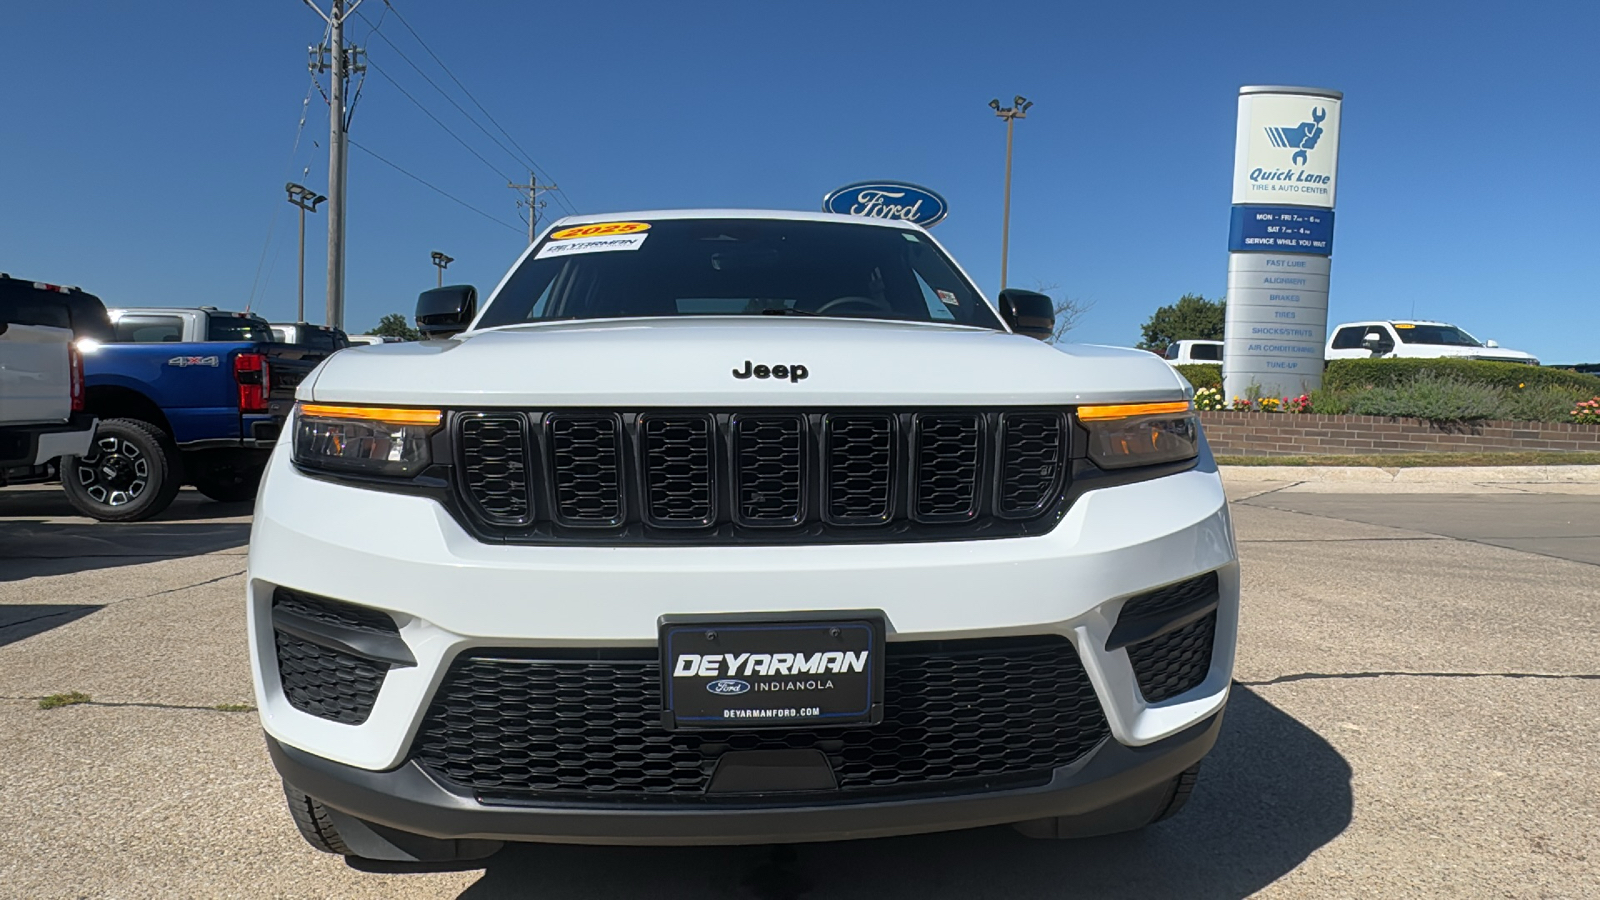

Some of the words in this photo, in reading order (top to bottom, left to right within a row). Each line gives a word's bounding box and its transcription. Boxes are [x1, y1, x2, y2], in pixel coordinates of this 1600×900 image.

[1250, 168, 1295, 182] Quick
[1296, 170, 1331, 184] Lane
[1301, 186, 1328, 194] CENTER
[850, 190, 923, 220] Ford
[561, 224, 640, 238] 2025
[1276, 238, 1297, 246] WHILE
[1266, 259, 1286, 267] FAST
[1263, 277, 1306, 286] ALIGNMENT
[1269, 294, 1300, 302] BRAKES
[1274, 311, 1296, 319] TIRES
[1252, 327, 1313, 337] SHOCKS/STRUTS
[1263, 345, 1315, 354] CONDITIONING
[1266, 361, 1298, 369] TUNE-UP
[732, 360, 809, 383] Jeep
[673, 651, 868, 677] DEYARMAN
[714, 679, 742, 693] Ford
[755, 680, 834, 691] INDIANOLA
[723, 707, 820, 718] DEYARMANFORD.COM
